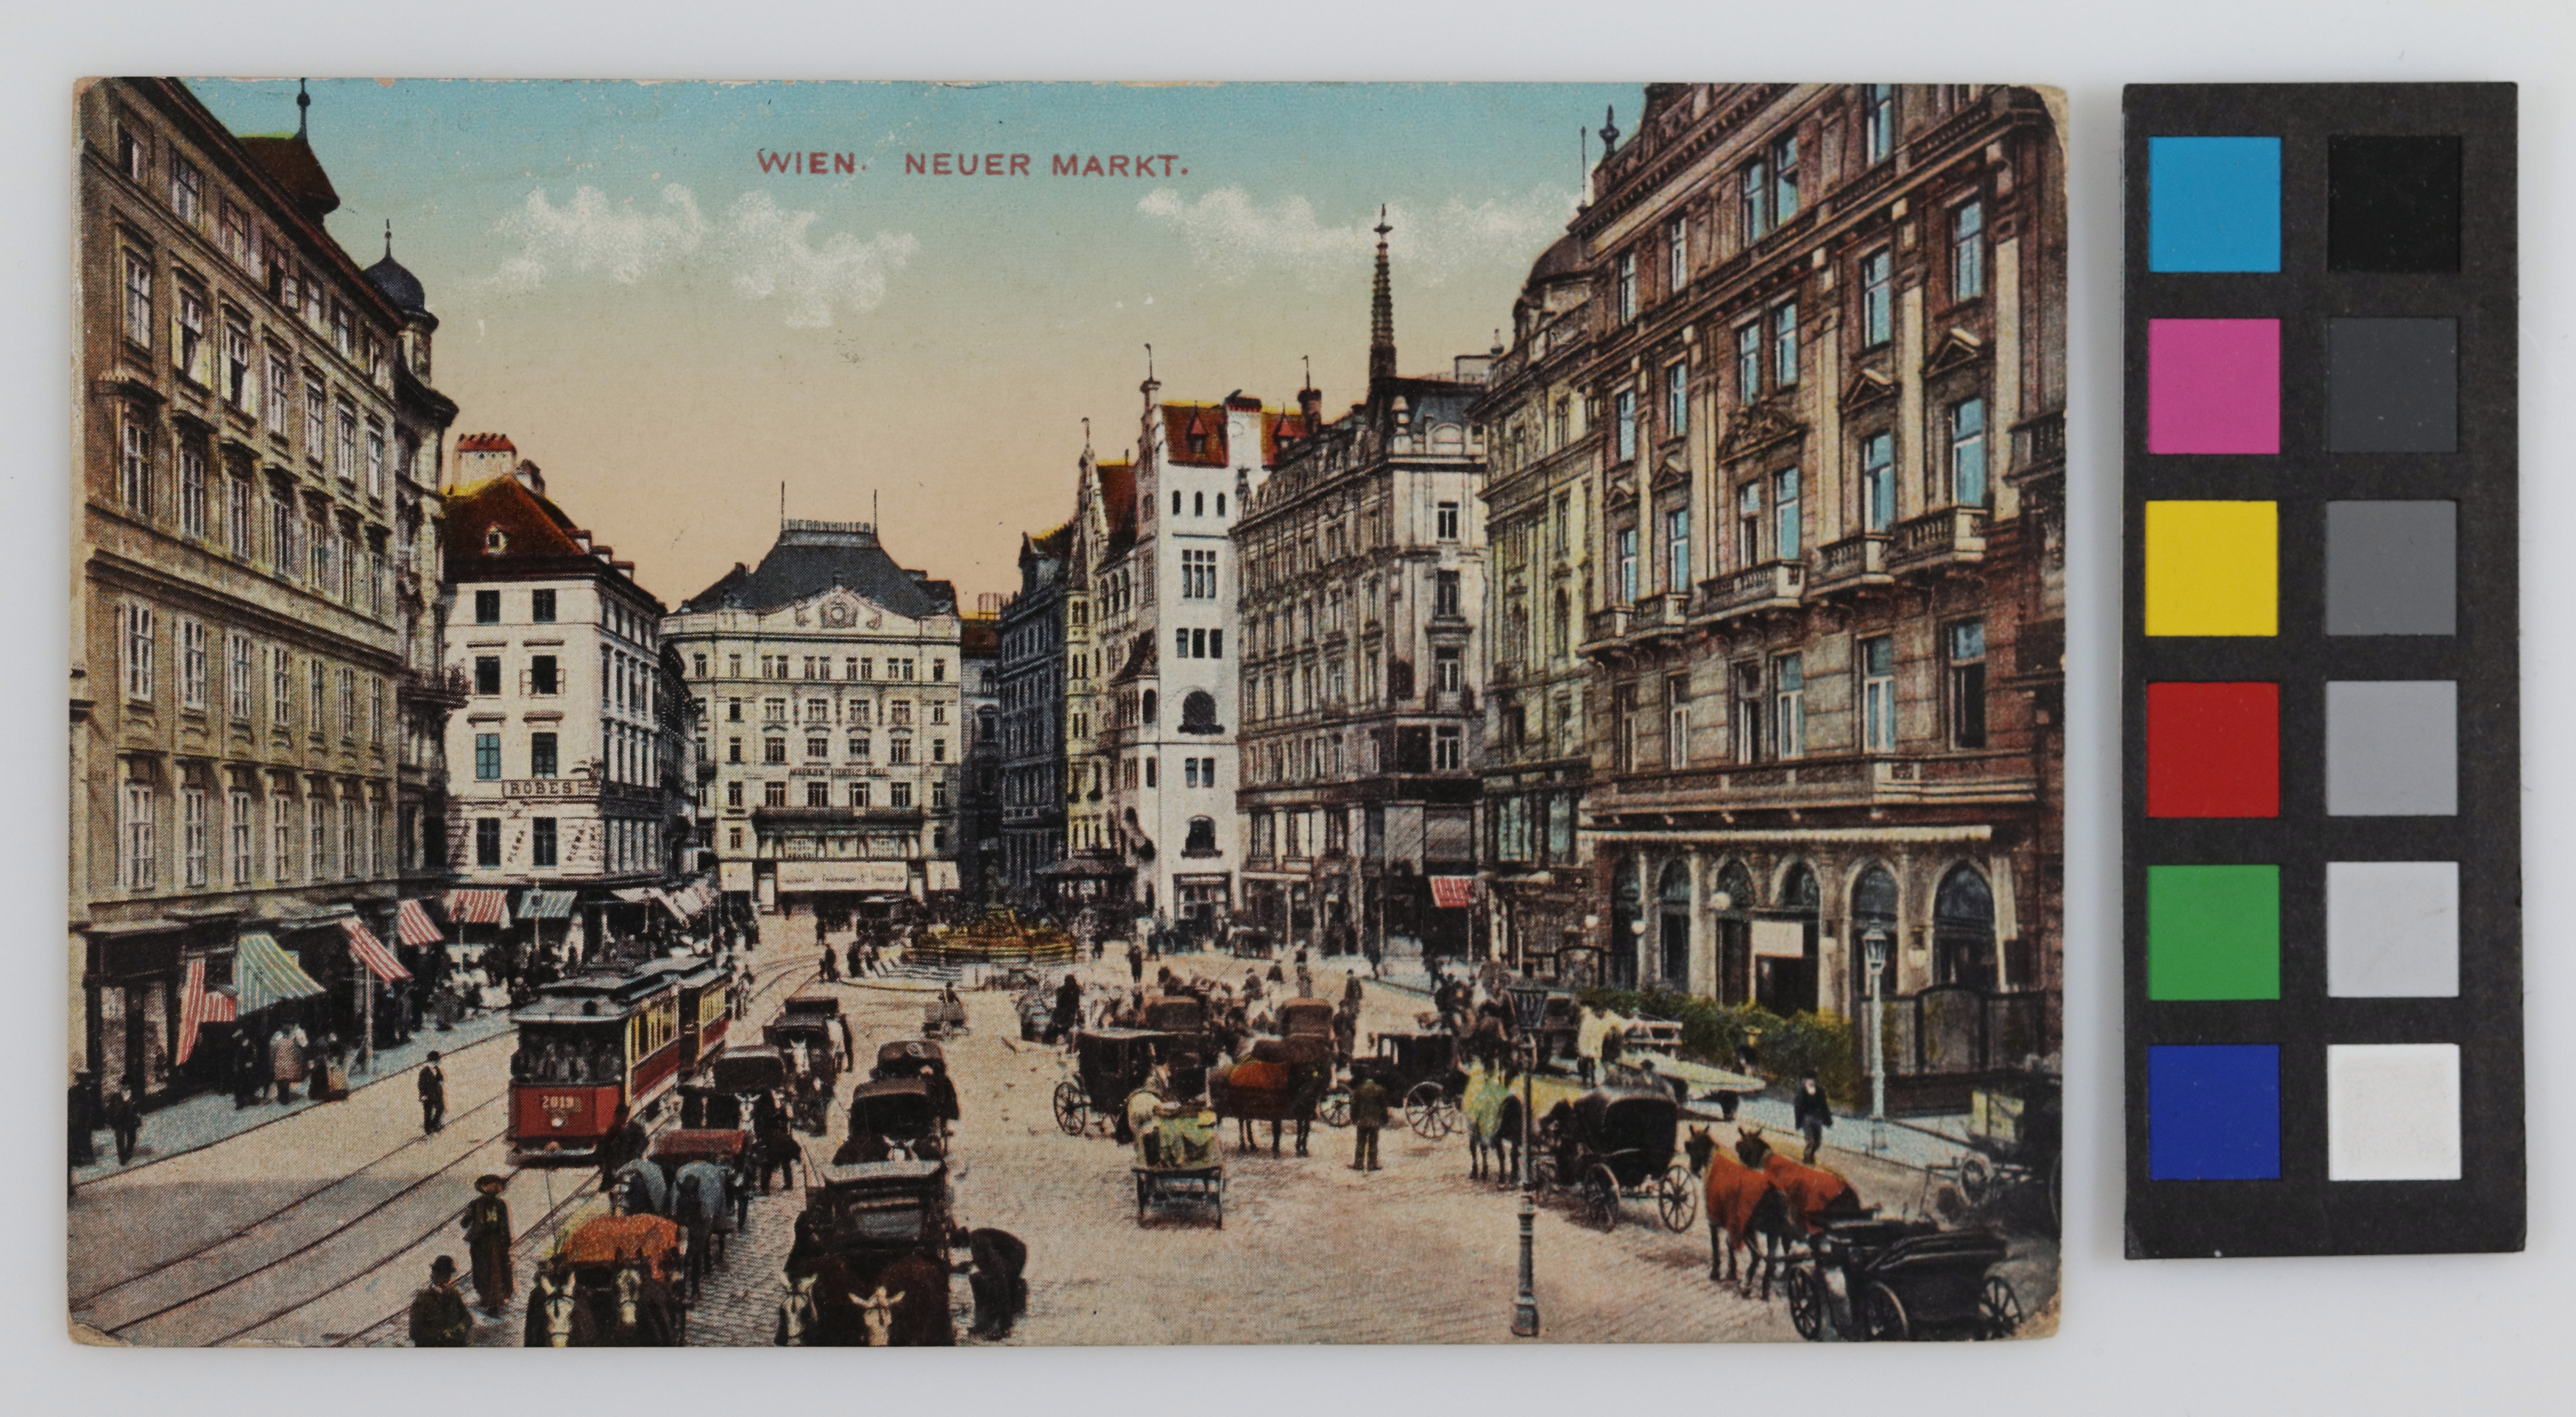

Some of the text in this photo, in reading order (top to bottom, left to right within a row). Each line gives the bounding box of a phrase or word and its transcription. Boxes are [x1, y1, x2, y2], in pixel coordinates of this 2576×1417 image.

[757, 151, 1189, 177] WIEN. NEUER MARKT.
[510, 780, 572, 794] ROBES
